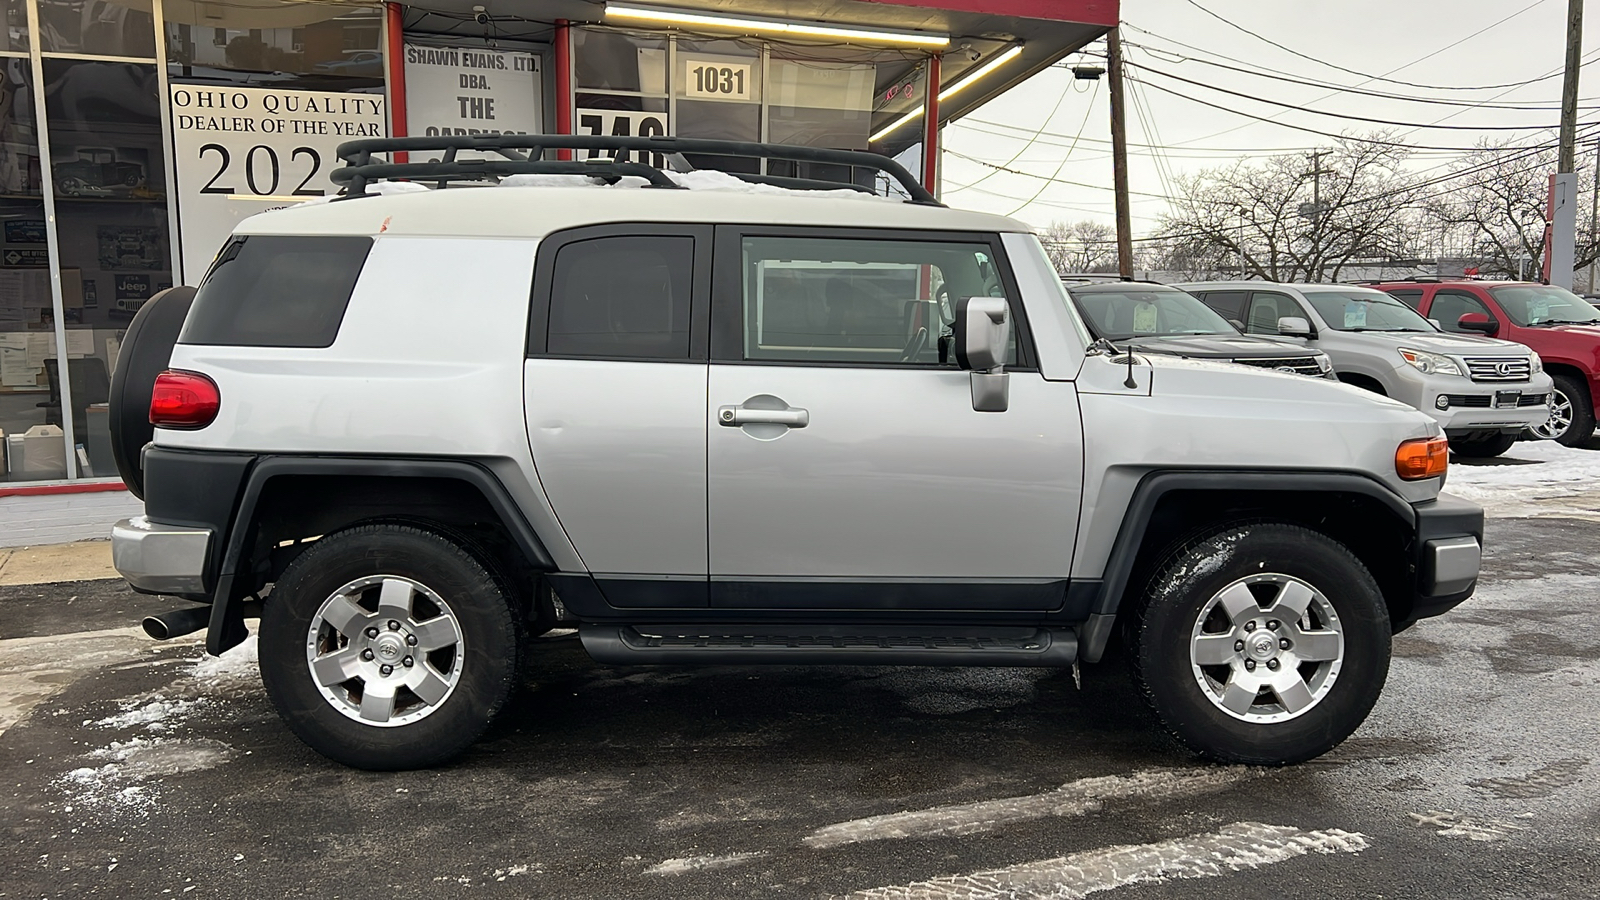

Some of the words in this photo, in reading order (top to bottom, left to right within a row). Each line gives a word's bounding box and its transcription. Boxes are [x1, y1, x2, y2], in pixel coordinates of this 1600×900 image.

[407, 48, 459, 67] SHAWN
[462, 52, 508, 70] EVANS.
[513, 56, 539, 73] LTD.
[459, 73, 491, 90] DBA.
[693, 66, 744, 94] 1031
[174, 90, 249, 110] OHIO
[262, 94, 383, 116] QUALITY
[457, 96, 495, 120] THE
[178, 114, 256, 132] DEALER
[261, 118, 286, 133] OF
[290, 119, 328, 135] THE
[332, 121, 381, 137] YEAR
[199, 143, 349, 197] 202
[118, 280, 147, 292] Jeep
